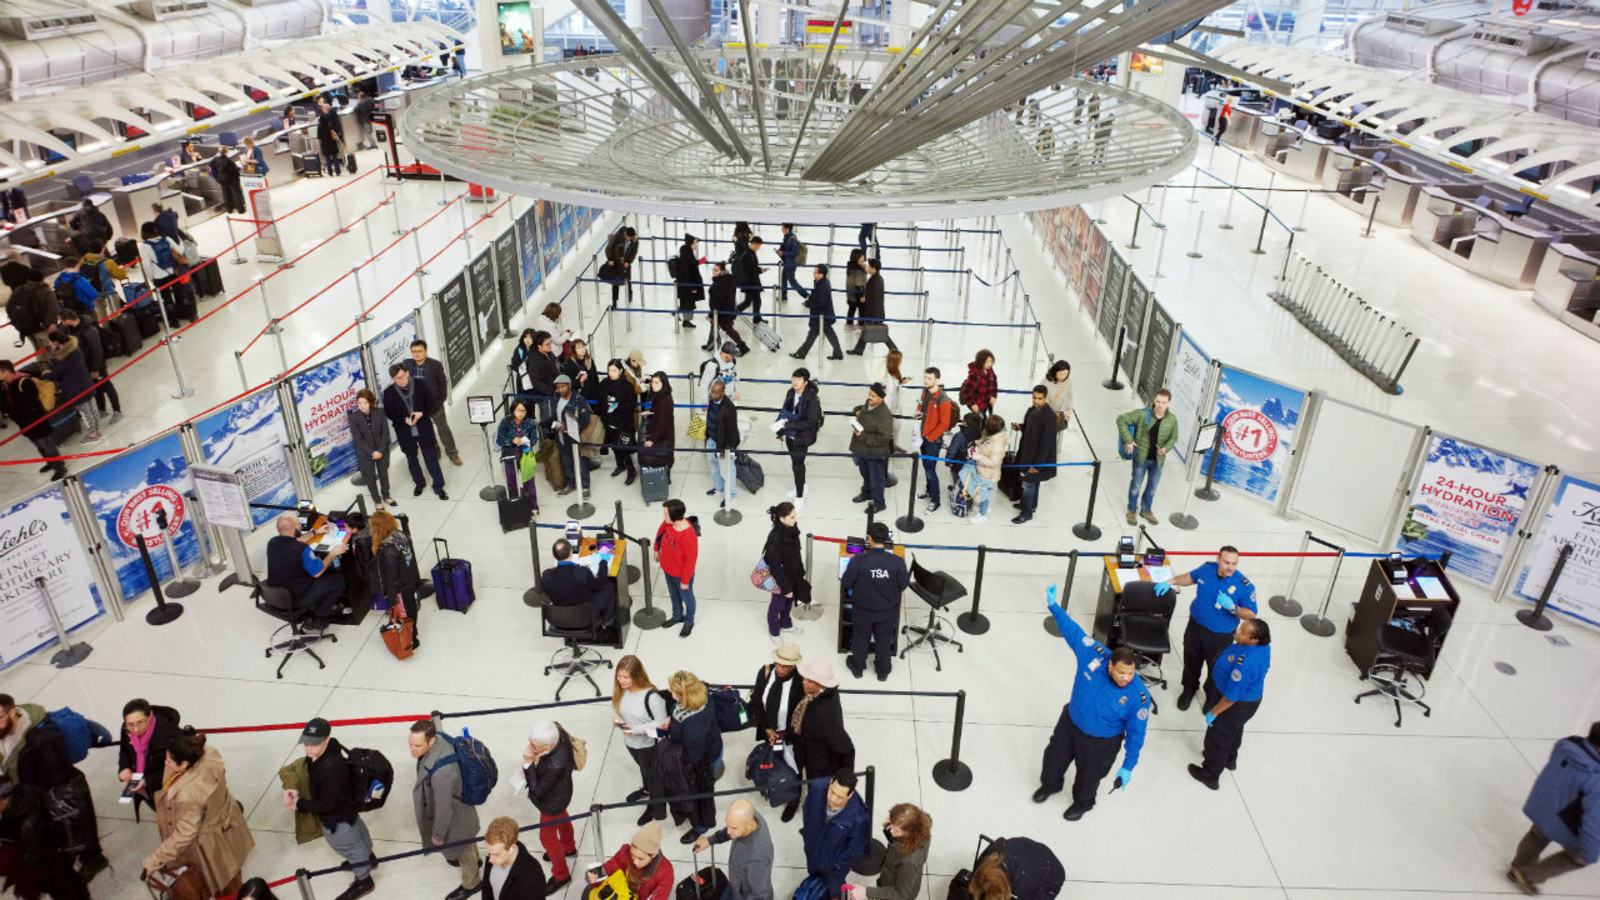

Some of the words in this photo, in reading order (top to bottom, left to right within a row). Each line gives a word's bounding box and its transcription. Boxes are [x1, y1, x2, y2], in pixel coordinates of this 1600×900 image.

[304, 399, 358, 431] HYDRATIO
[310, 388, 356, 416] 24-HOUR
[1236, 425, 1262, 448] #1
[1421, 483, 1515, 523] HYDRATION
[1436, 475, 1507, 507] 24-HOUR
[869, 569, 890, 579] TSA
